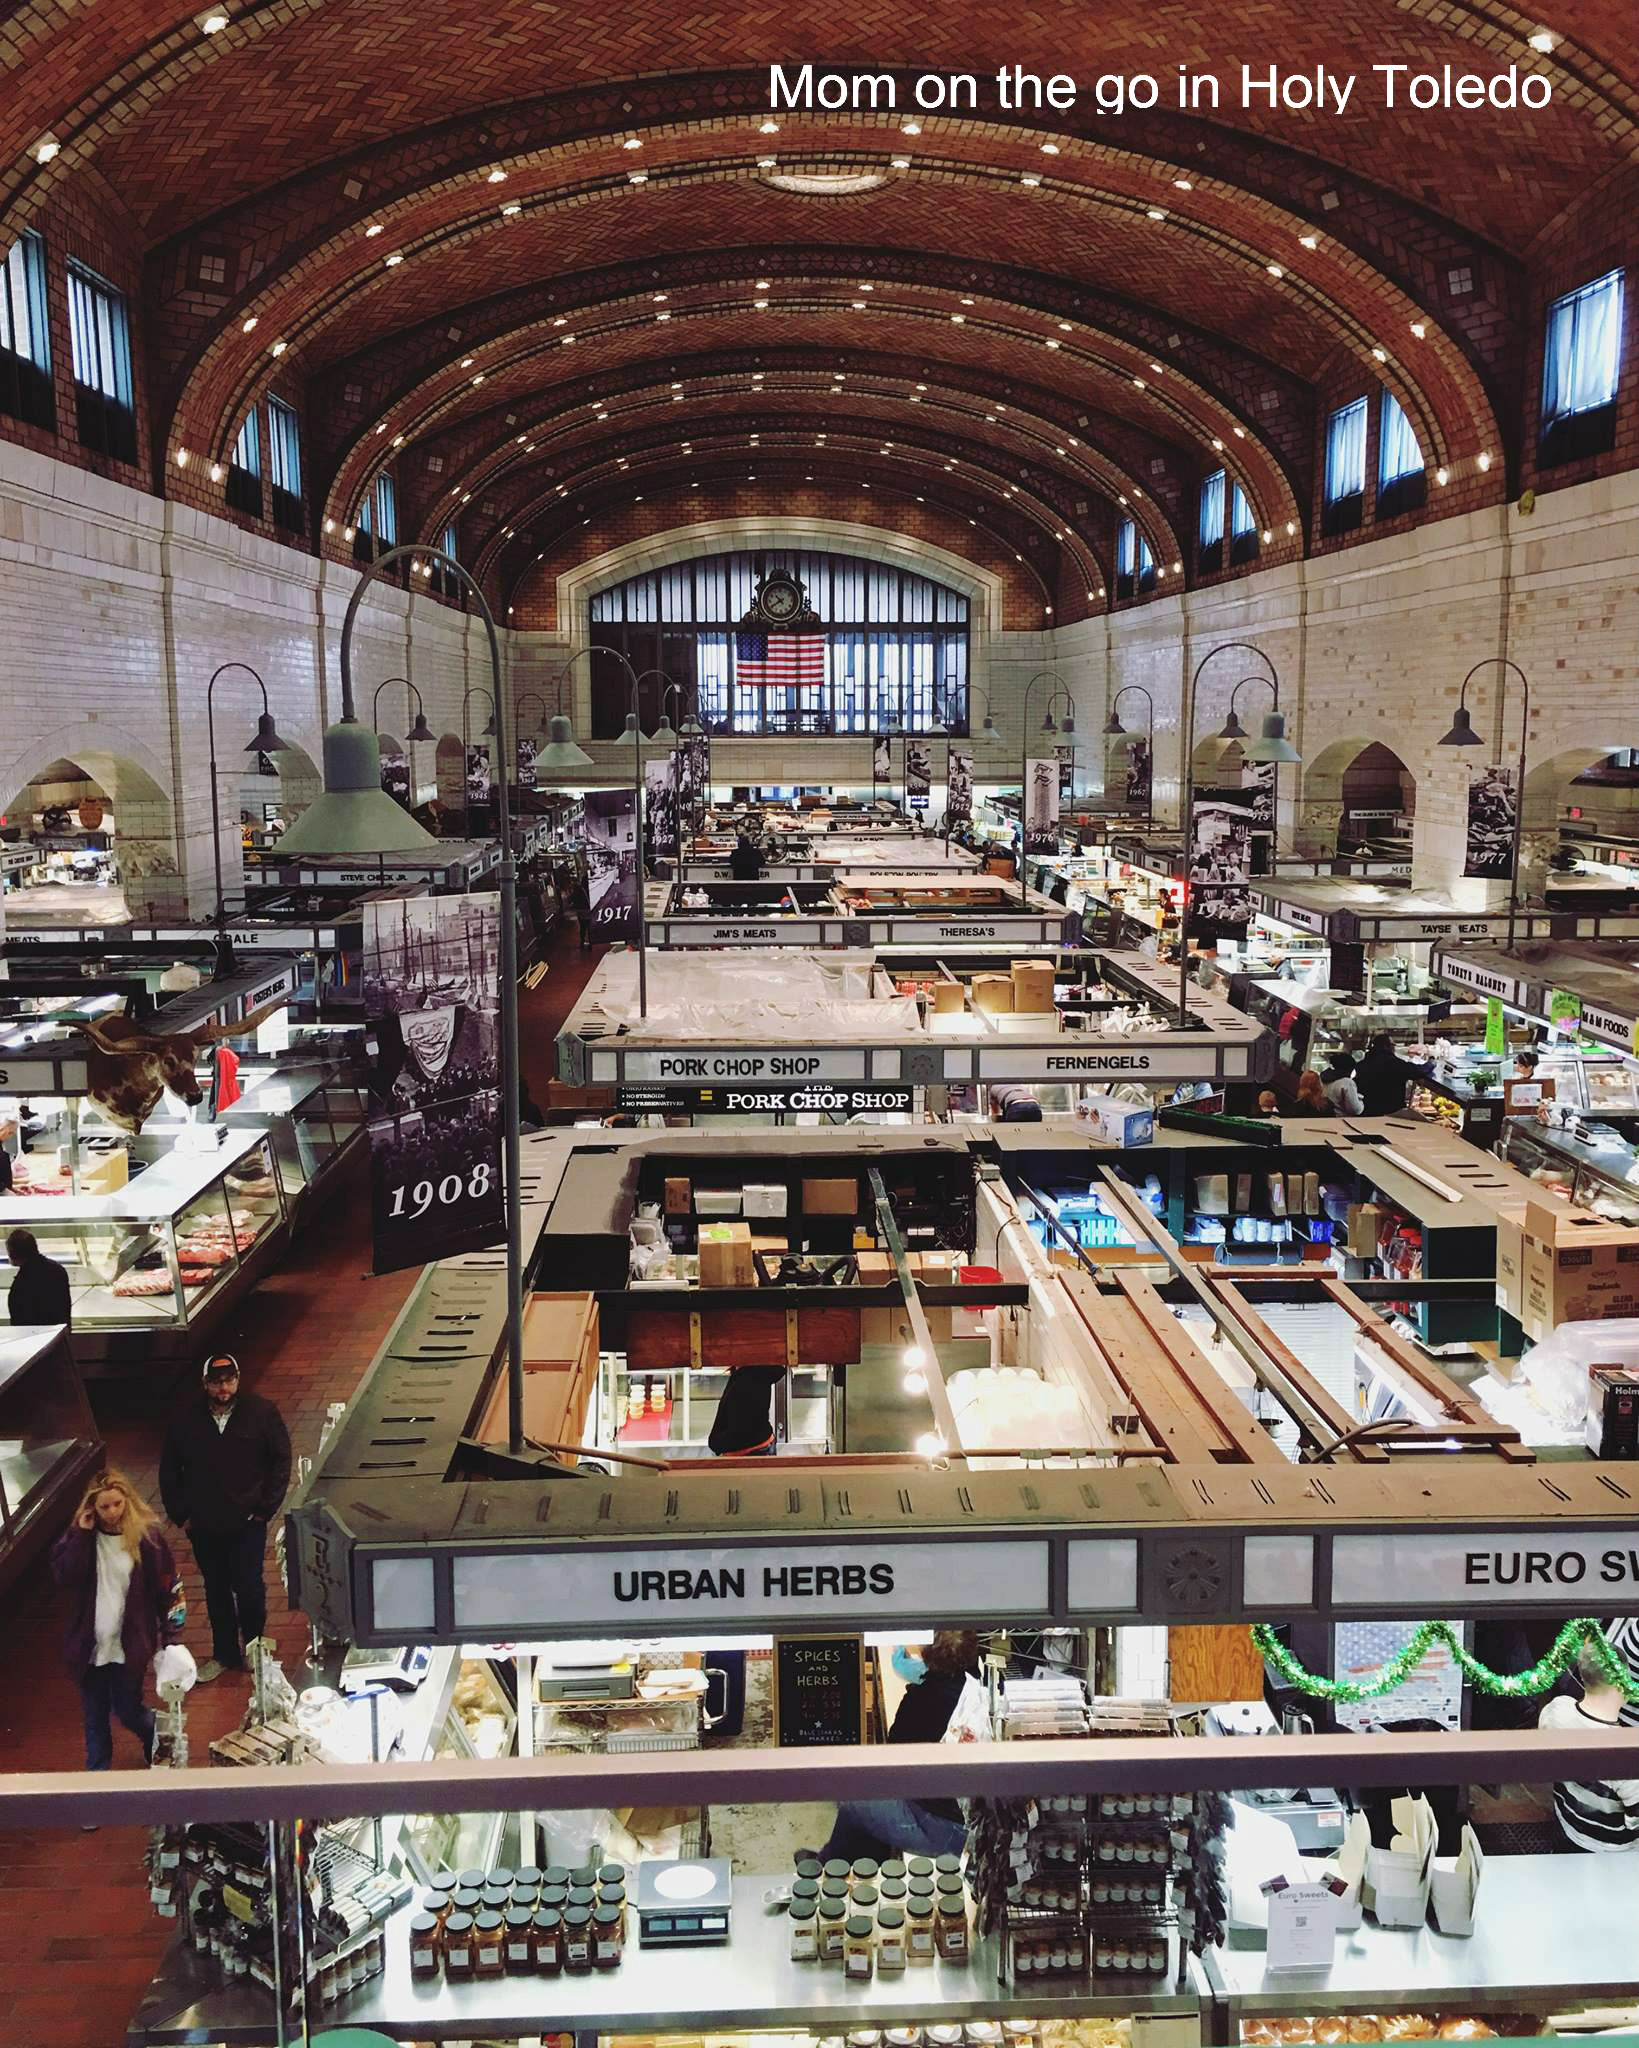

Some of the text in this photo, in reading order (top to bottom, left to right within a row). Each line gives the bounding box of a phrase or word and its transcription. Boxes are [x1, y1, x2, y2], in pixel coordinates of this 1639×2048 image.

[651, 834, 674, 845] 1927
[1030, 831, 1054, 843] 1976
[1472, 851, 1506, 865] 1977
[340, 874, 364, 882] STEVE
[595, 904, 632, 924] 1917
[1197, 901, 1243, 920] 1977
[713, 929, 777, 938] JIM'S MEATS
[939, 927, 995, 936] THERESA'S
[1421, 924, 1451, 934] TAYSE
[1604, 1019, 1629, 1038] FOODS
[660, 1057, 820, 1077] PORK CHOP SHOP
[1046, 1056, 1150, 1069] FERNENGELS
[726, 1092, 910, 1110] PORK CHOP SHOP
[388, 1162, 490, 1220] 1908
[1465, 1551, 1586, 1585] EURO
[613, 1563, 895, 1602] URBAN HERBS
[794, 1650, 841, 1663] SPICES
[797, 1675, 839, 1687] HERBS
[1299, 1891, 1329, 1899] Sweets
